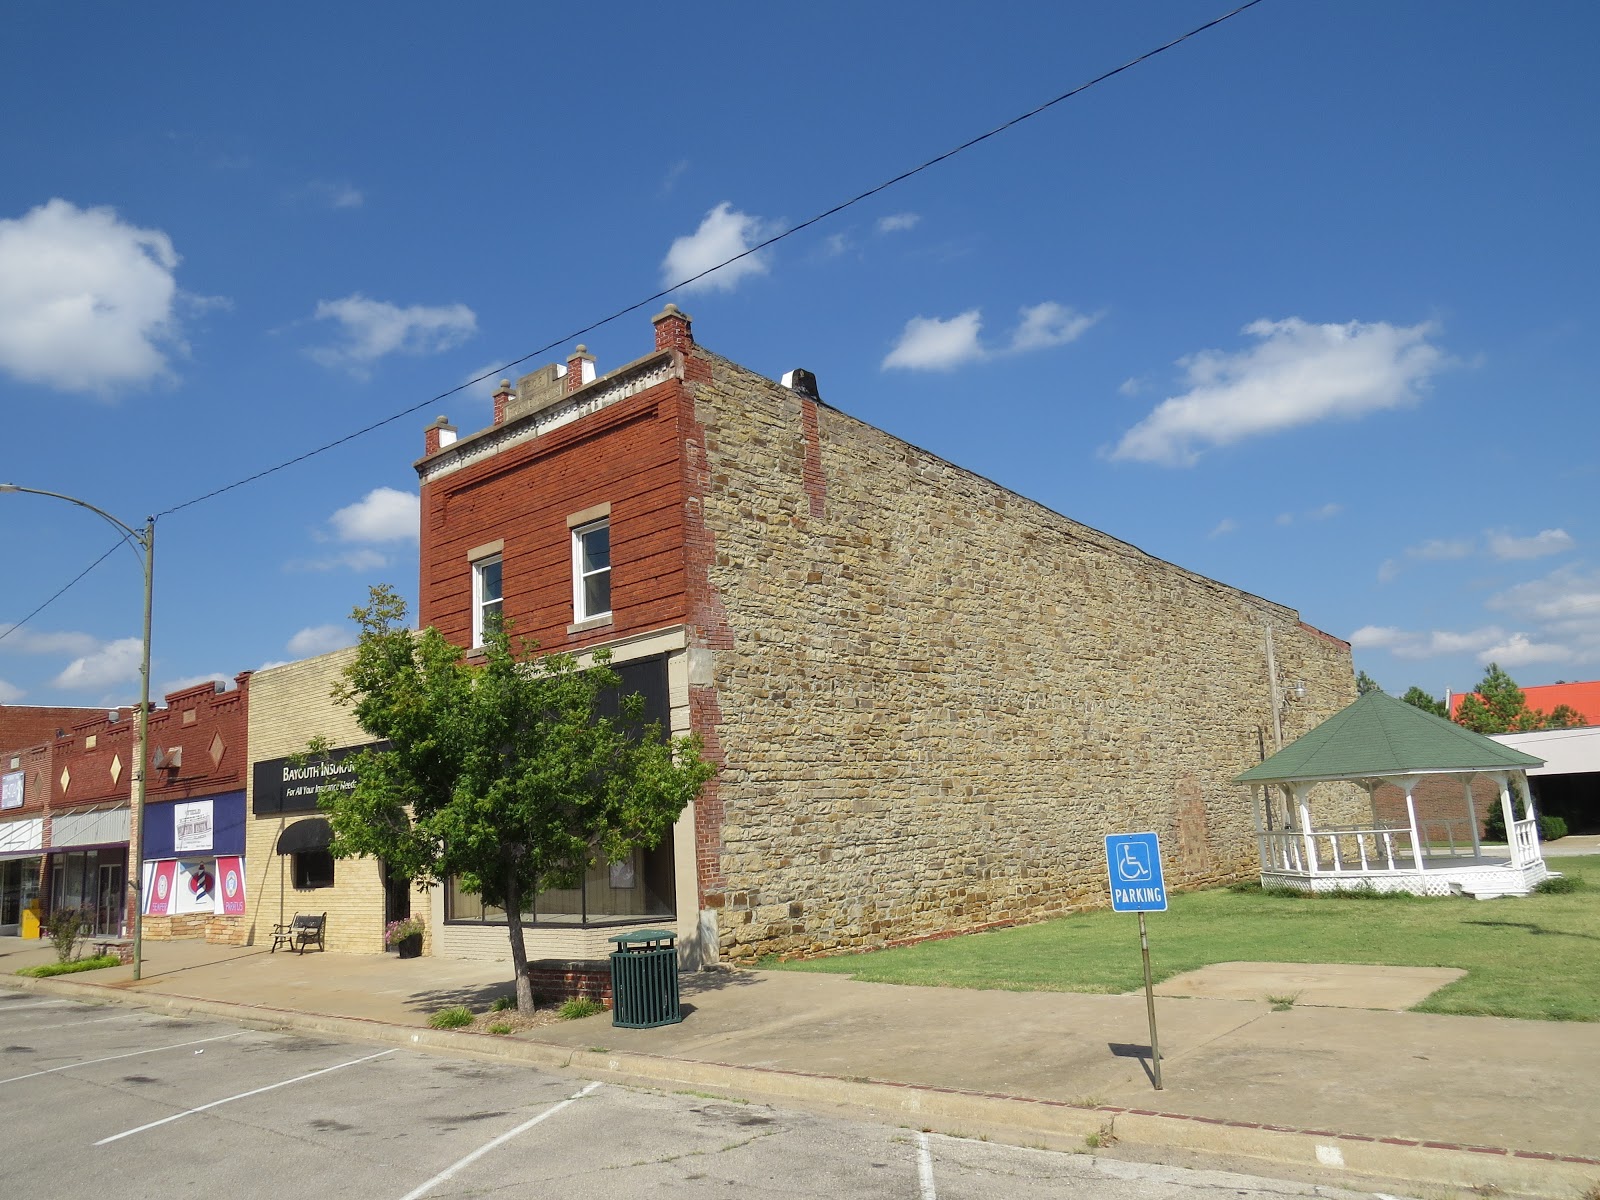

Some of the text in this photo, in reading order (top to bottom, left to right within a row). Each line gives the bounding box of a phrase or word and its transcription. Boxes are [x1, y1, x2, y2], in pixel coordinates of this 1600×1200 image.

[283, 766, 319, 782] BAYOUTH
[286, 788, 296, 797] For
[303, 785, 315, 795] Your
[1115, 887, 1161, 903] PARKING
[152, 902, 167, 912] SEMPER
[225, 901, 243, 911] PARATUS
